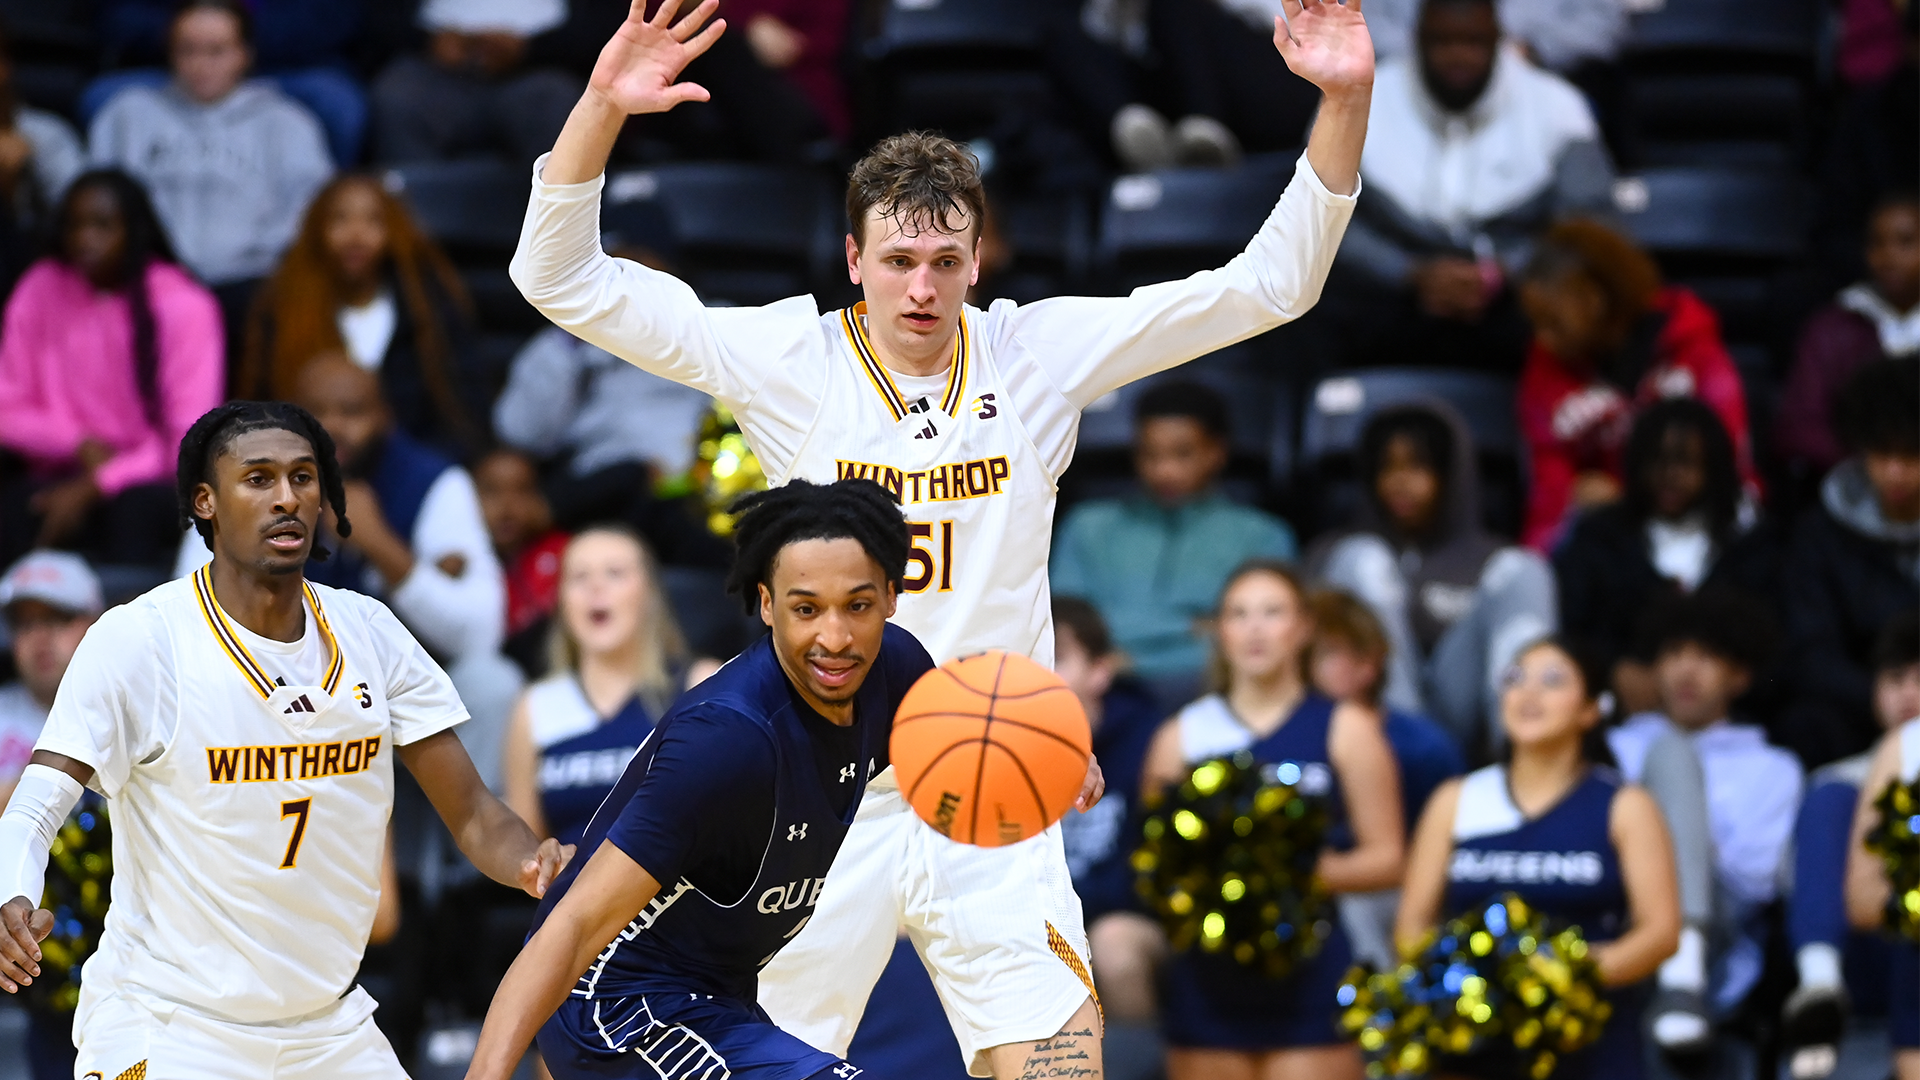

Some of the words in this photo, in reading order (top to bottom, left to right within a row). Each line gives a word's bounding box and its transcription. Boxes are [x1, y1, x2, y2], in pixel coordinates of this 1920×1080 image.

[903, 519, 953, 594] 51
[205, 735, 382, 783] WINTHROP
[278, 796, 313, 870] 7
[756, 877, 826, 915] QUE
